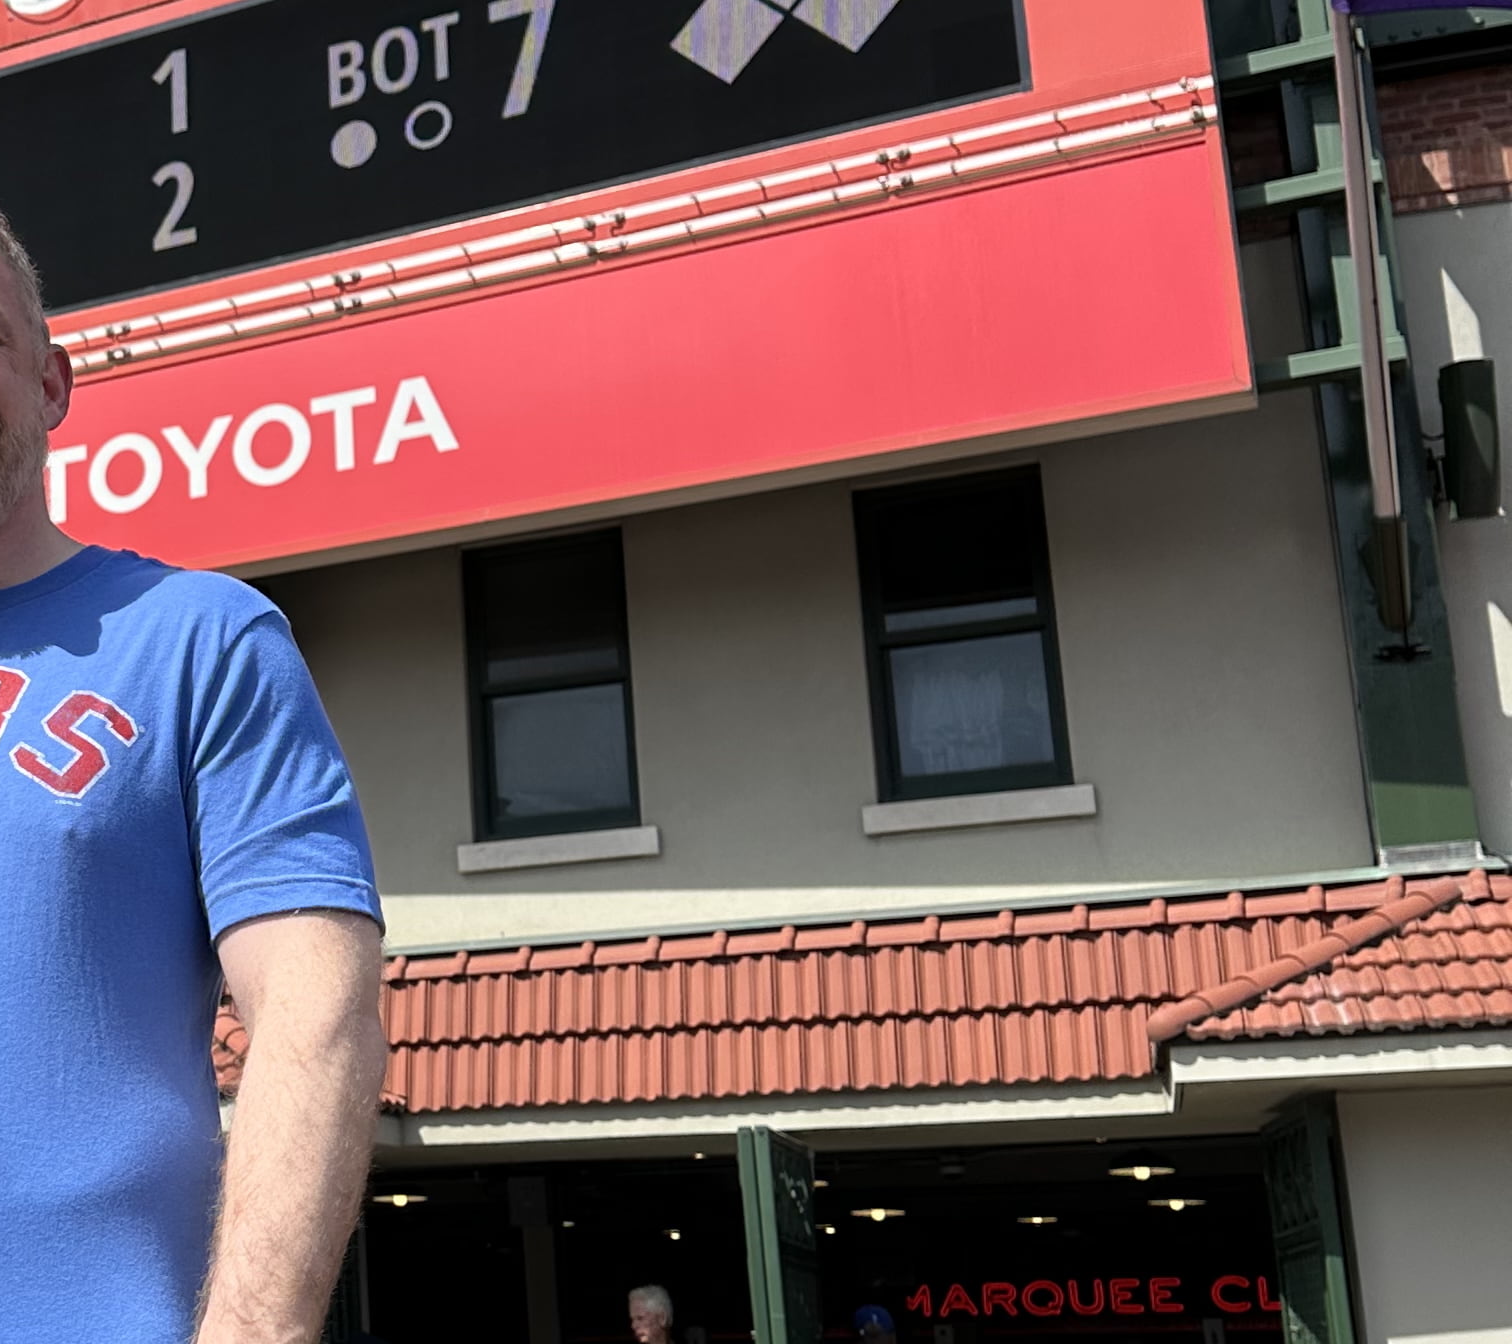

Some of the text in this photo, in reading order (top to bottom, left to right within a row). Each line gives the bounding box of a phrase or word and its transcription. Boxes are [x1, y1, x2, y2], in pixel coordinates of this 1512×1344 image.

[151, 48, 188, 134] 1
[327, 12, 460, 109] BOT
[151, 161, 198, 252] 2
[47, 376, 459, 524] TOYOTA
